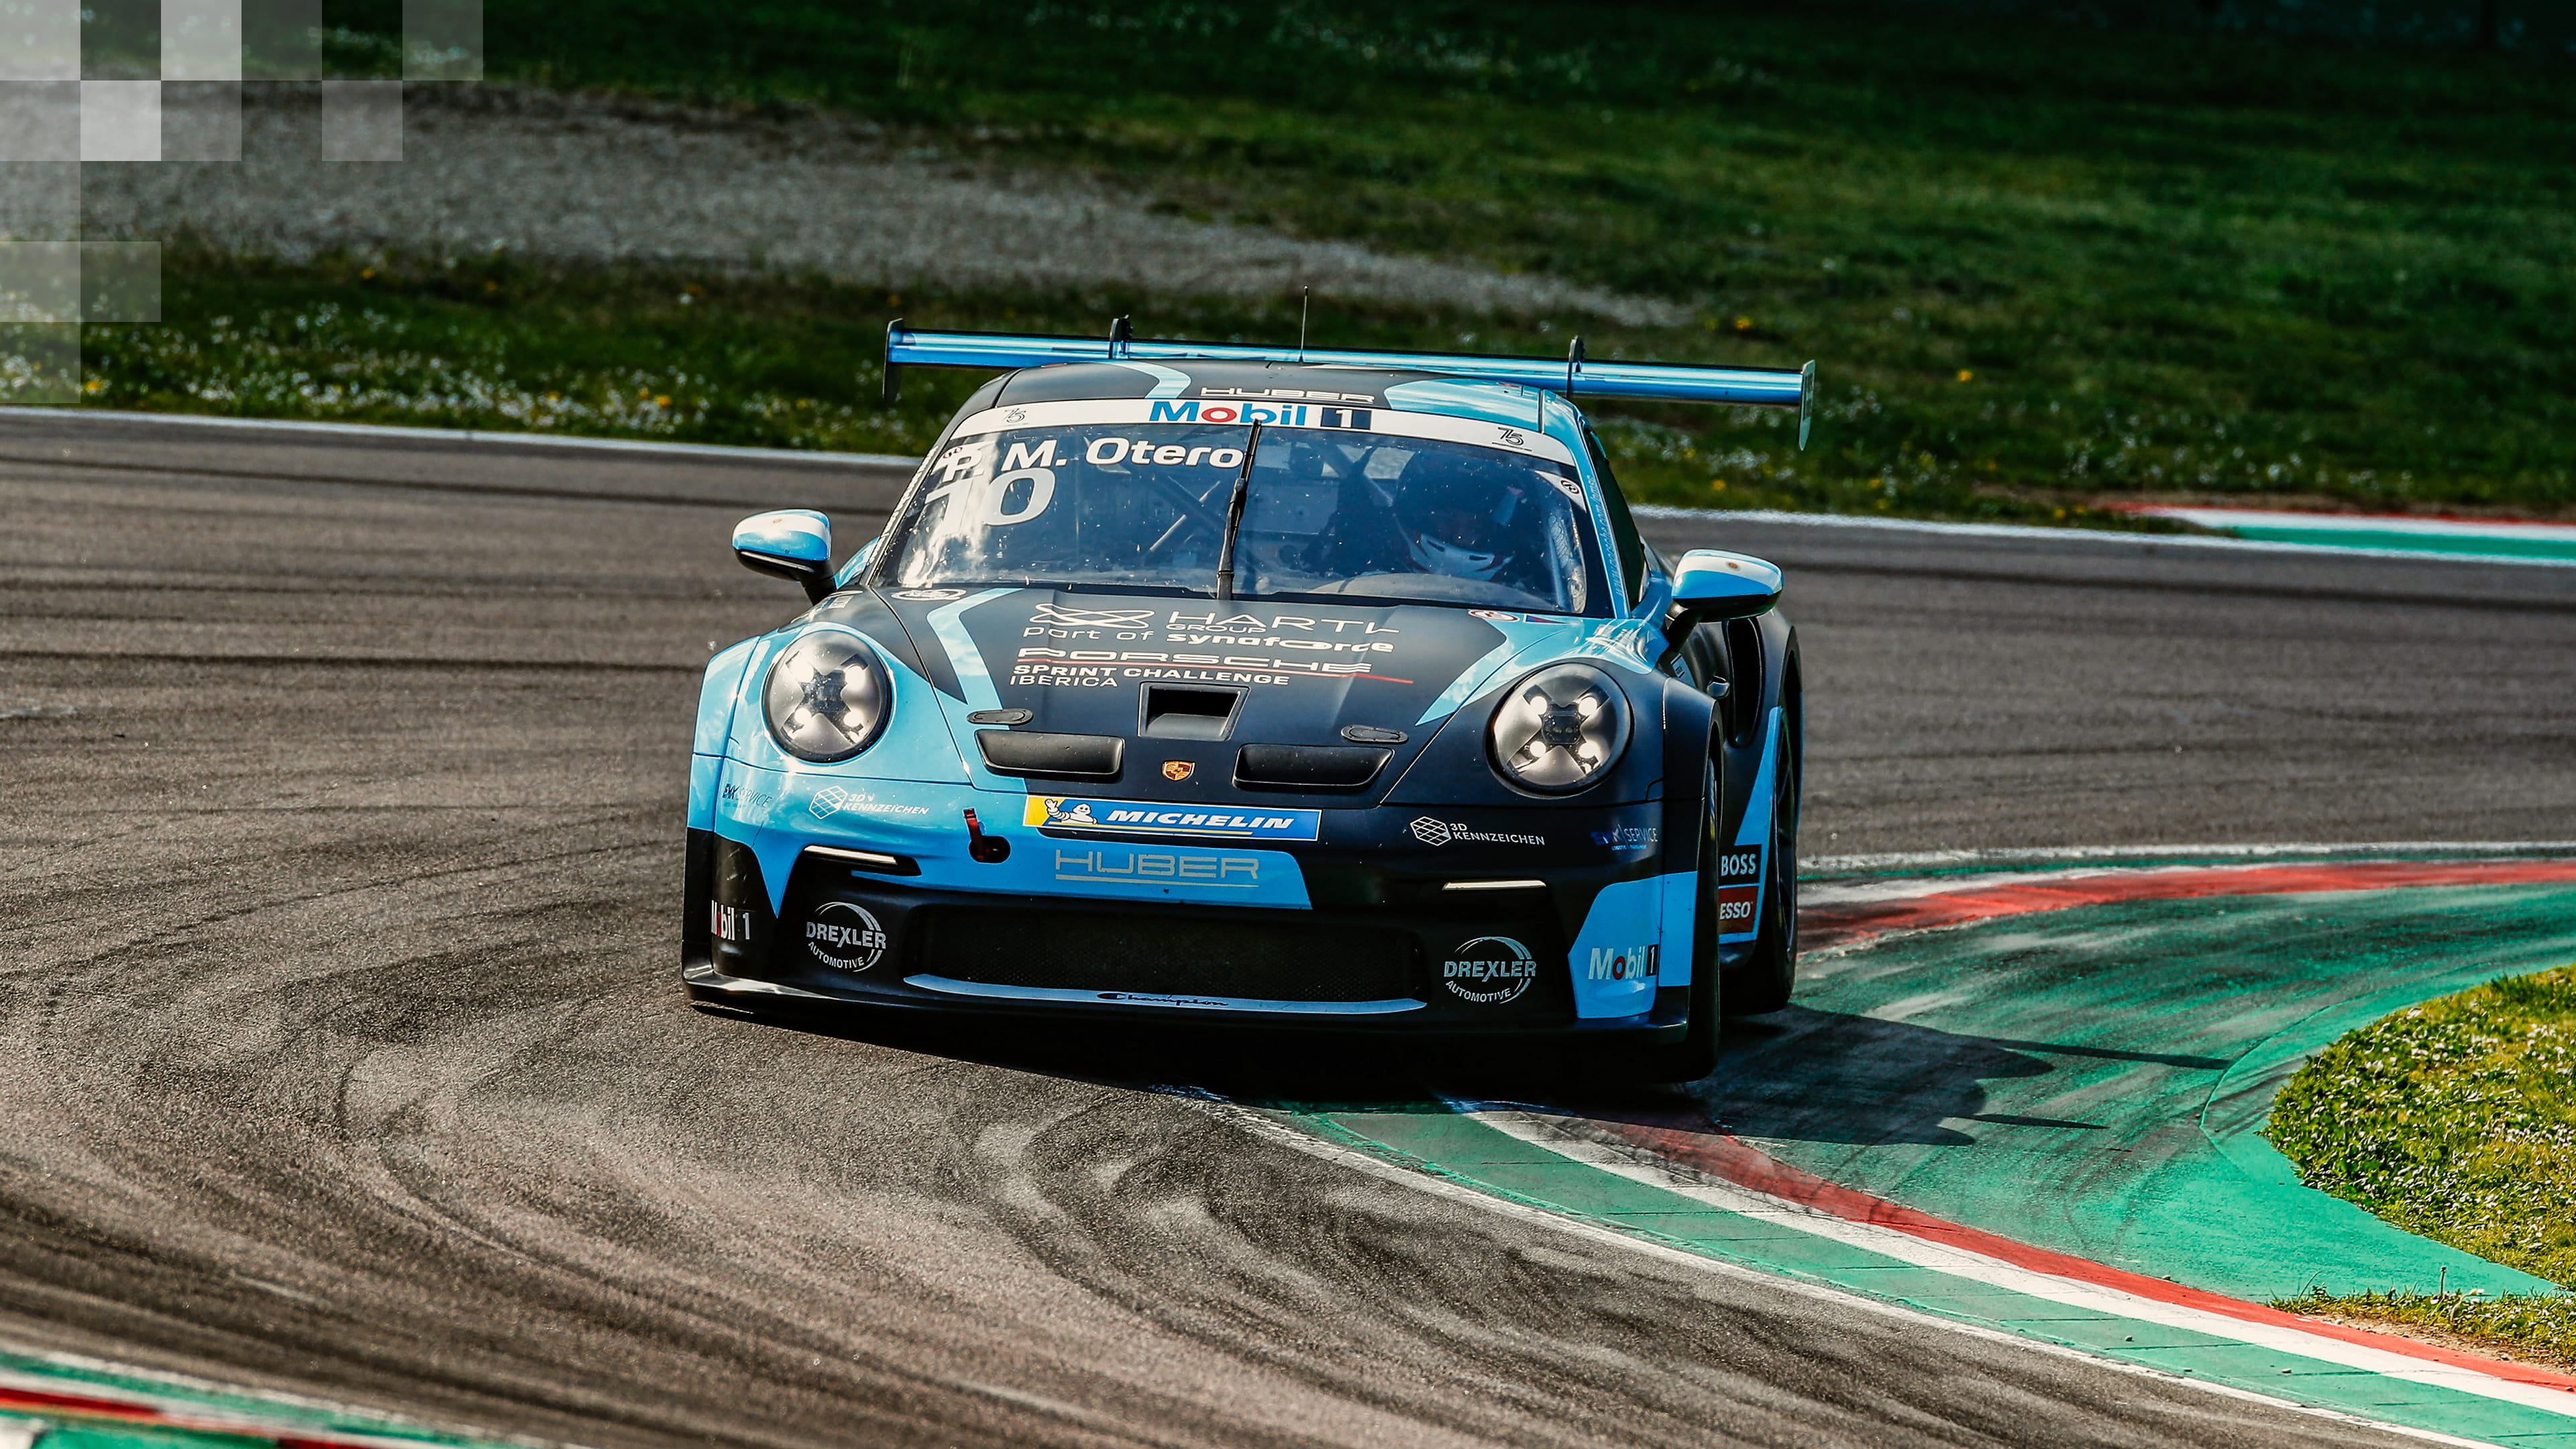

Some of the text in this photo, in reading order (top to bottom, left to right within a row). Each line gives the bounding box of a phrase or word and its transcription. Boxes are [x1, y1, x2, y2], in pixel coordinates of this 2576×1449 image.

[1200, 387, 1375, 404] HUBER
[1148, 400, 1307, 426] Mobil
[1001, 439, 1068, 472] M.
[1085, 437, 1244, 469] Otero
[924, 468, 1057, 534] 10
[1165, 623, 1267, 634] GROUP
[1168, 611, 1400, 635] HARTL
[1022, 627, 1395, 653] part of synaforce
[1017, 647, 1373, 674] PORSCHE
[1009, 675, 1118, 688] IBERICA
[1013, 664, 1291, 686] SPRINT CHALLENGE
[843, 802, 930, 815] KENNZEICHEN
[1106, 810, 1295, 830] MICHELIN
[1449, 823, 1468, 832] 3D
[1452, 832, 1546, 846] KENNZEICHEN
[1623, 827, 1658, 843] SERVICE
[1055, 849, 1259, 879] HUBER
[1720, 853, 1757, 877] BOSS
[742, 912, 751, 940] 1
[806, 921, 887, 950] DREXLER
[808, 941, 865, 969] AUTOMOTIVE
[1588, 945, 1646, 981] Mobil
[1443, 961, 1537, 983] DREXLER
[1097, 991, 1229, 1006] Champion
[1445, 980, 1512, 1003] AUTOMOTIVE
